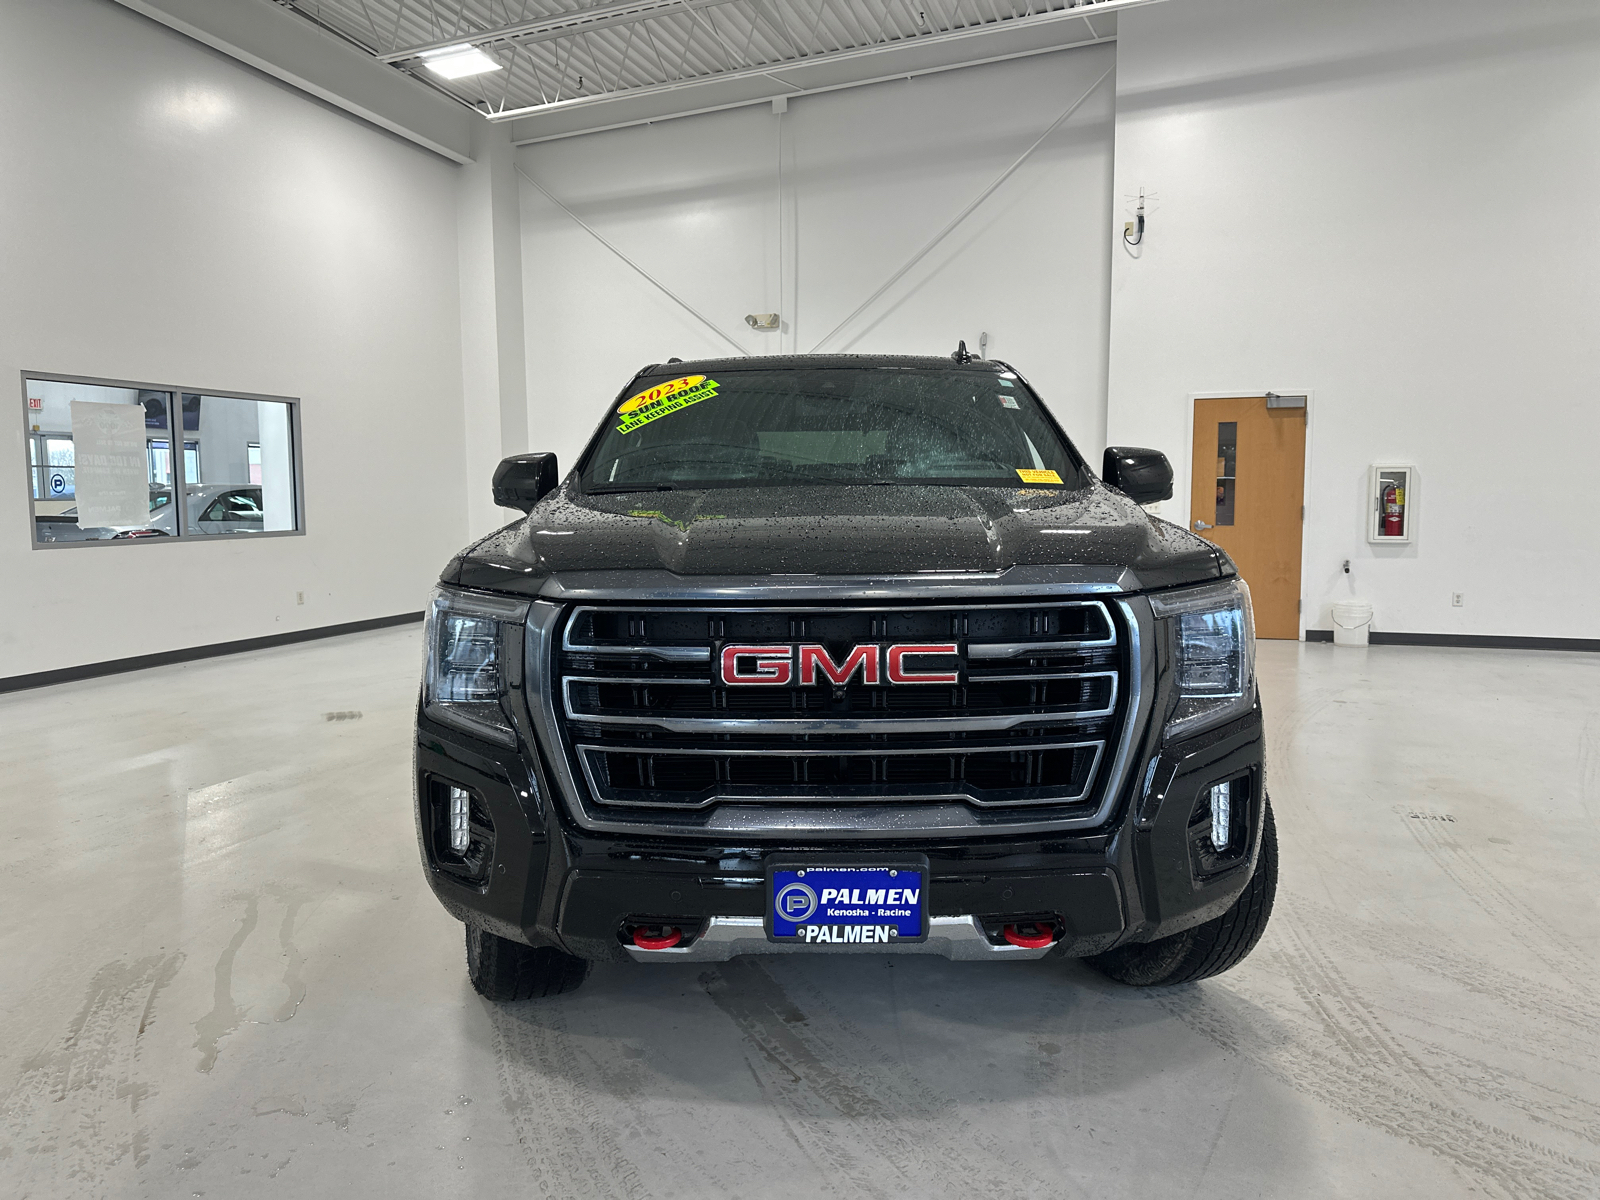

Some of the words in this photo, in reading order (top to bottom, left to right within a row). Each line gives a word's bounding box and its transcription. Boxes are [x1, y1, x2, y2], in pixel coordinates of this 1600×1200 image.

[30, 399, 42, 408] EXIT
[628, 399, 664, 419] SUN
[666, 381, 712, 402] ROOF
[635, 378, 690, 408] 2023
[619, 418, 645, 433] LANE
[644, 401, 683, 421] KEEPING
[684, 389, 715, 404] ASSIST
[721, 644, 958, 685] GMC
[820, 888, 920, 905] PALMEN
[827, 908, 869, 917] Kenosha
[877, 908, 911, 917] Racine
[805, 925, 890, 943] PALMEN
